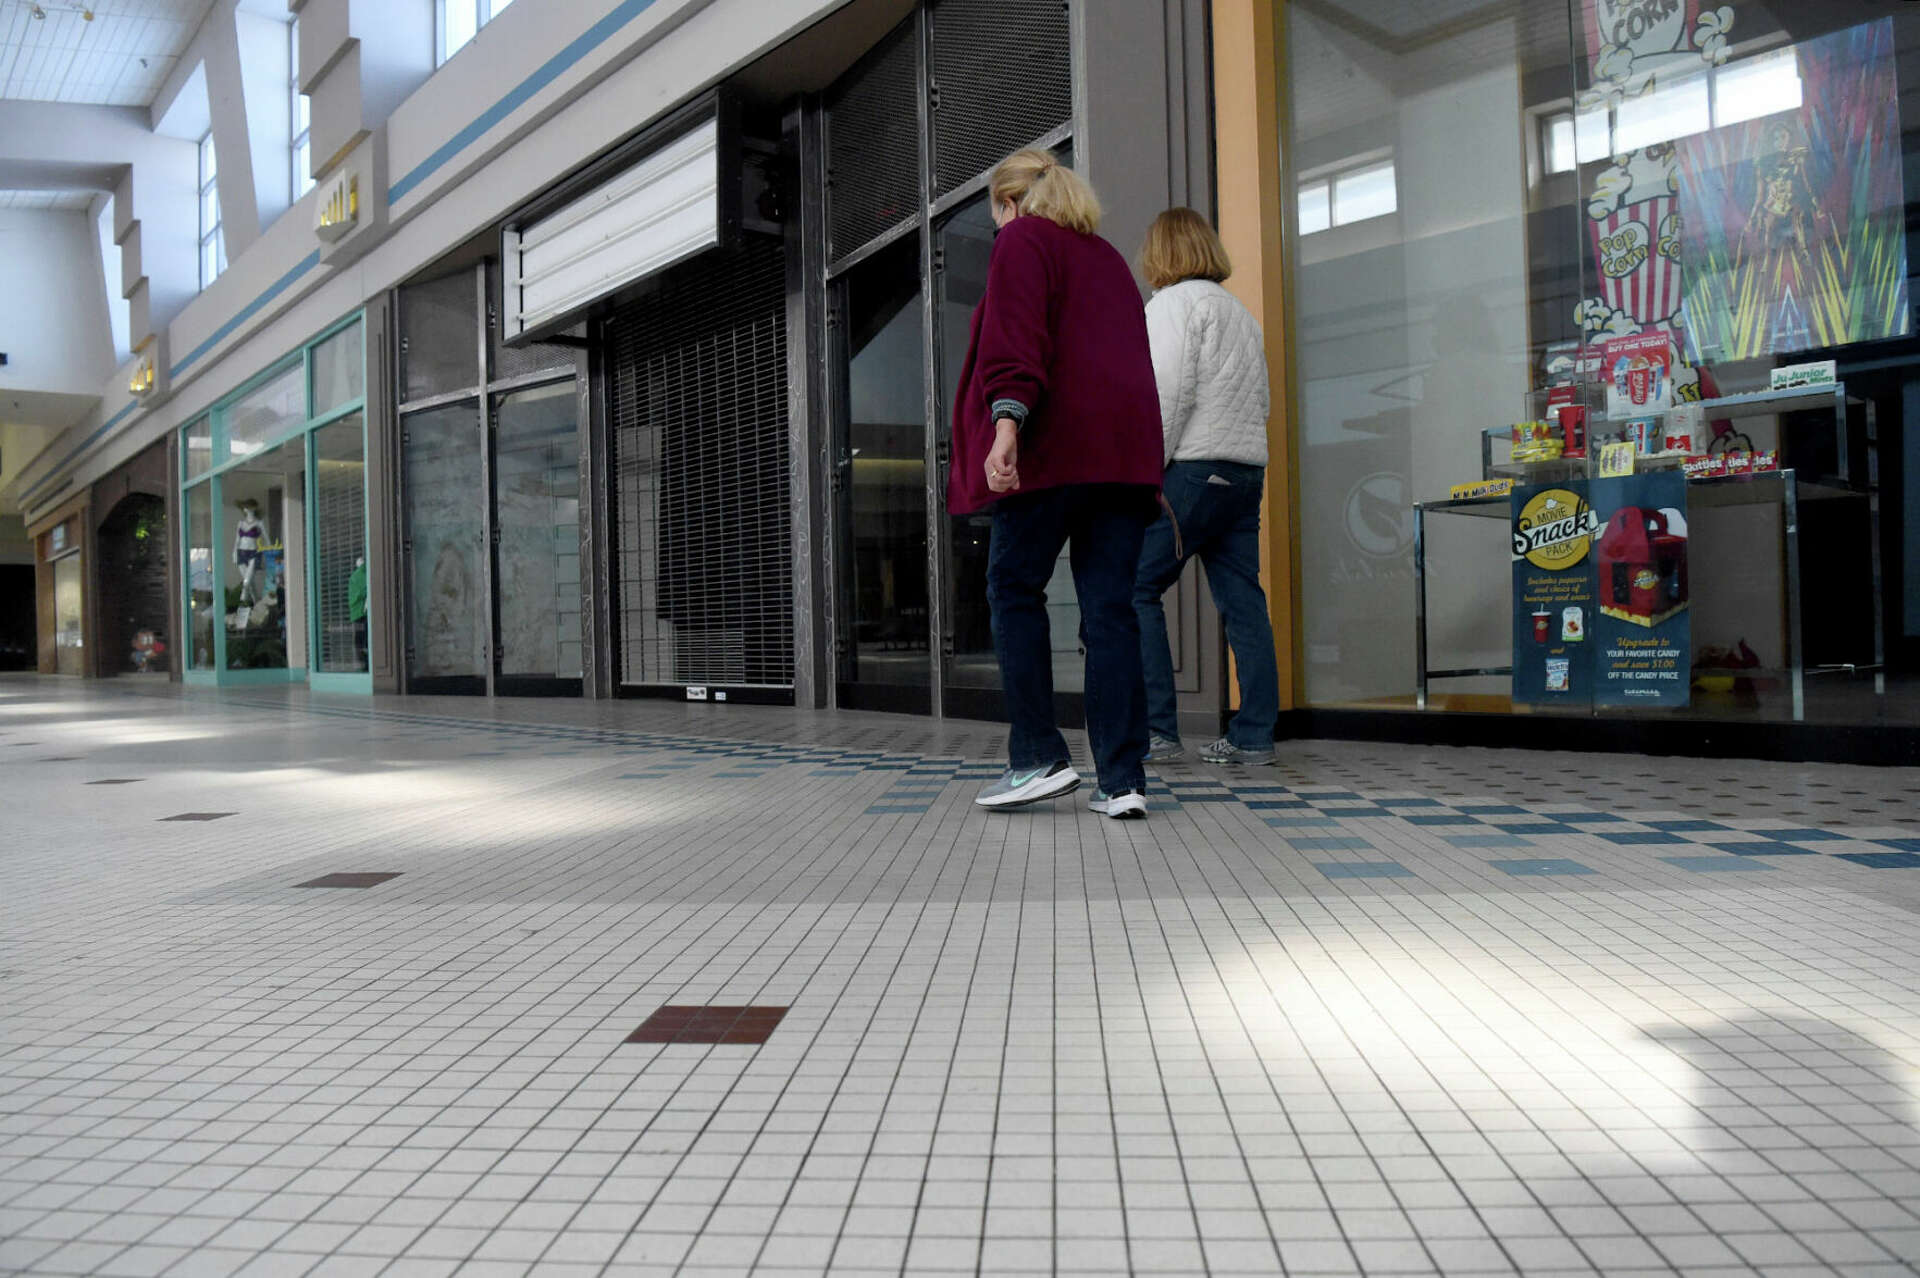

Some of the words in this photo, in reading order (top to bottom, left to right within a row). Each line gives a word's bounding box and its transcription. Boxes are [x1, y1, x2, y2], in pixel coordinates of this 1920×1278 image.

[1599, 228, 1637, 258] Pop
[1658, 236, 1681, 259] Co
[1603, 245, 1649, 278] Corn
[1789, 368, 1827, 380] Junior
[1682, 458, 1722, 474] Skittles
[1727, 457, 1749, 467] tles
[1536, 506, 1568, 524] MOVIE
[1512, 496, 1592, 556] Snack
[1546, 543, 1573, 557] PACK
[1606, 649, 1624, 658] YOUR
[1625, 649, 1656, 658] FAVORITE
[1657, 649, 1681, 658] CANDY
[1607, 671, 1620, 679] OFF
[1621, 671, 1635, 679] THE
[1635, 671, 1658, 680] CANDY
[1658, 671, 1680, 680] PRICE
